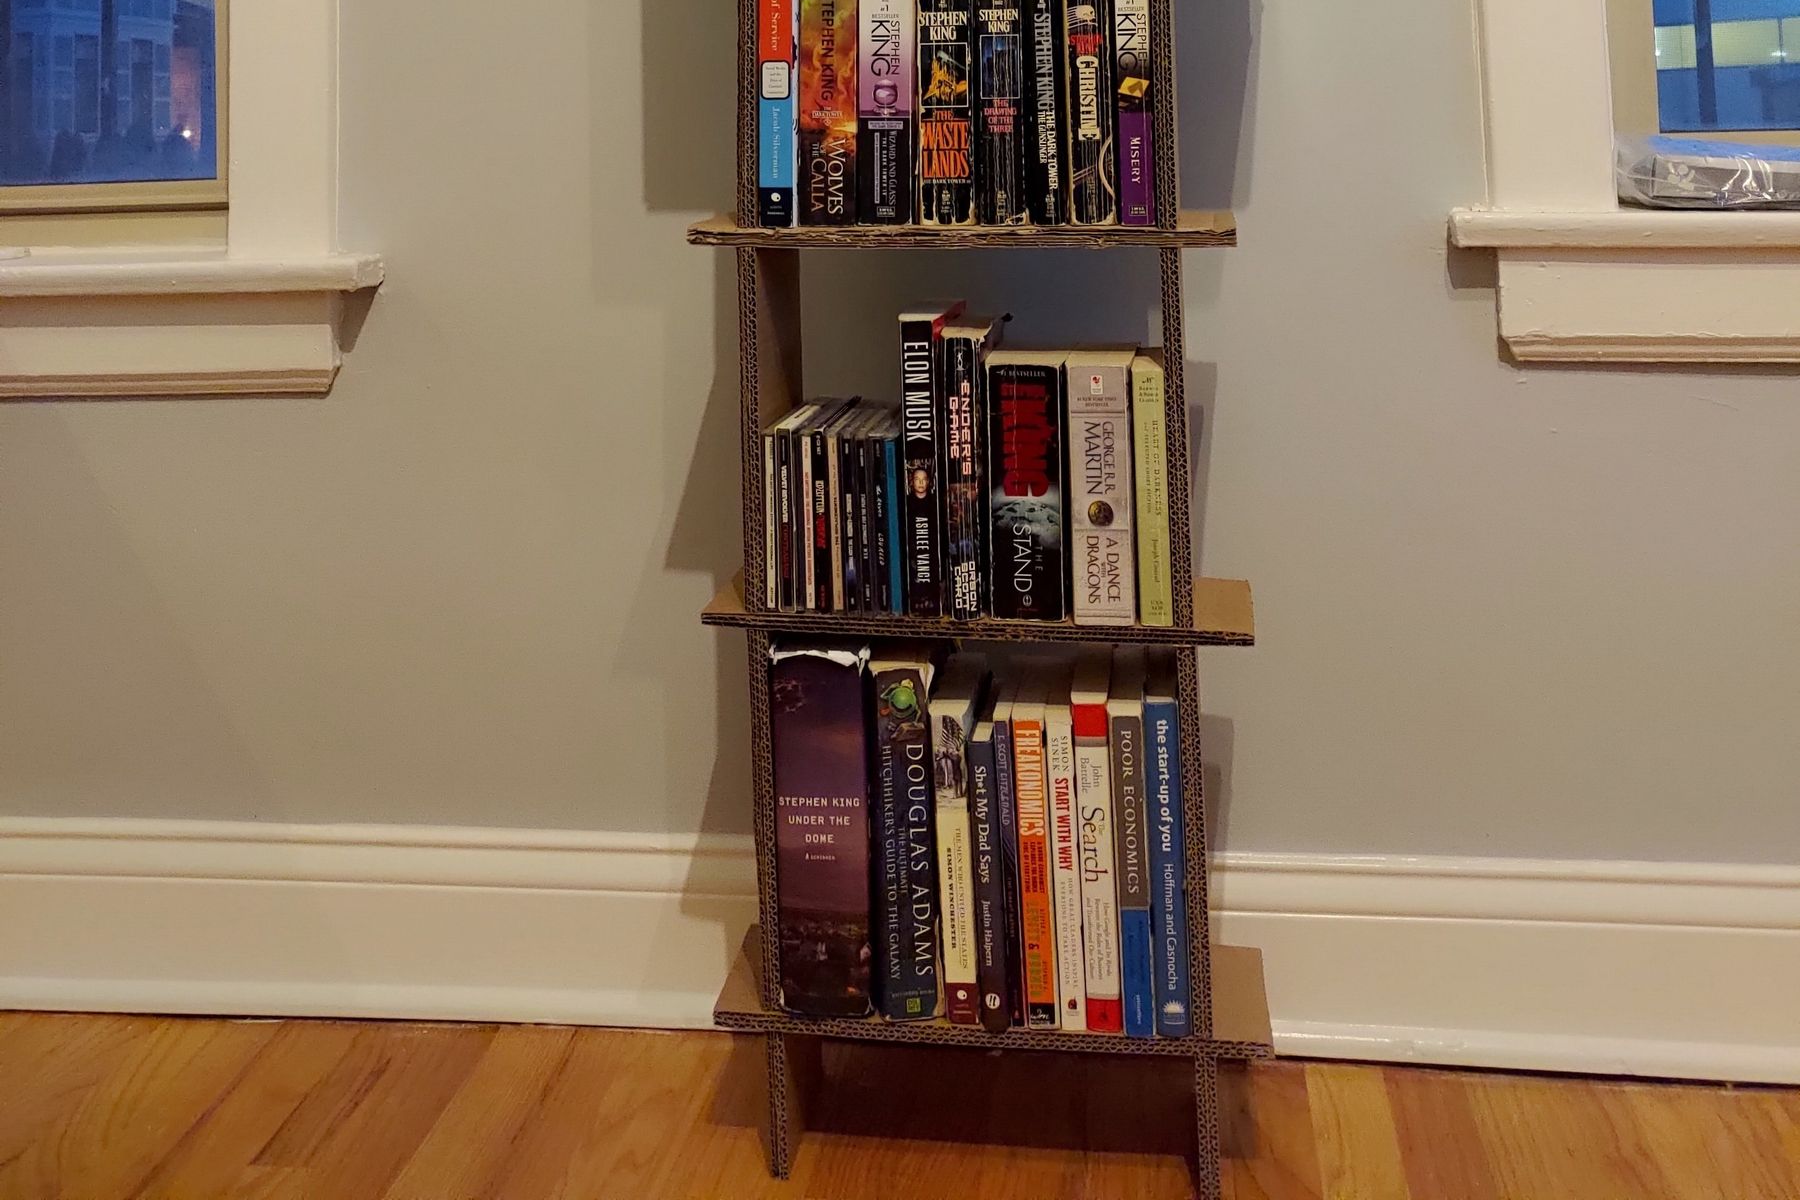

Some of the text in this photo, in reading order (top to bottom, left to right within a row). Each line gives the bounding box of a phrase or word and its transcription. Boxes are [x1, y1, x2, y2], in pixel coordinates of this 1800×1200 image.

[770, 12, 781, 52] Service
[919, 11, 967, 27] STEPHEN
[929, 25, 957, 42] KING
[979, 8, 1019, 22] STEPHEN
[988, 20, 1010, 34] KING
[870, 19, 891, 77] KING
[890, 20, 901, 75] STEPHEN
[1034, 13, 1055, 111] STEPHEN KING
[1117, 13, 1138, 71] KING
[821, 63, 835, 102] KING
[992, 99, 1009, 108] THE
[1076, 55, 1102, 142] CHRISTINE
[922, 120, 969, 151] WASTE
[935, 110, 953, 121] THE
[983, 106, 1017, 116] DRAWING
[987, 124, 1014, 133] THREE
[771, 106, 781, 179] Jacob Silverman
[811, 142, 820, 157] THE
[1037, 110, 1048, 164] THE GUNSLINGER
[1045, 110, 1059, 190] THE DARK TOWER
[1129, 136, 1142, 186] MISERY
[811, 158, 827, 212] CALLA
[827, 138, 846, 215] WOLVES
[888, 130, 899, 206] WIZARD AND GLASS
[923, 150, 970, 179] LANDS
[903, 341, 932, 442] ELON MUSK
[949, 396, 960, 459] GAME
[961, 379, 972, 476] ENDER'S
[1000, 400, 1050, 498] KING
[1102, 421, 1116, 471] GEORGE
[1151, 419, 1160, 449] HEART
[1084, 421, 1104, 495] MARTIN
[1153, 468, 1163, 517] DARKNESS
[914, 516, 931, 583] ASHLEE VANCE
[1012, 522, 1033, 593] STAND
[1034, 545, 1044, 572] THE
[1086, 535, 1101, 604] DRAGONS
[1106, 537, 1121, 603] A DANCE
[953, 566, 963, 610] CARD
[960, 561, 970, 611] SCOTT
[968, 560, 978, 612] ORSON
[1050, 737, 1061, 772] SINEK
[1060, 735, 1071, 773] SIMON
[1080, 757, 1092, 794] Battelle
[1091, 763, 1103, 788] John
[1120, 730, 1134, 779] POOR
[778, 796, 861, 808] STEPHEN KING
[904, 743, 930, 872] DOUGLAS
[996, 743, 1010, 826] SCOTT FITZGERALD
[1016, 729, 1045, 836] FREAKONOMICS
[1157, 719, 1172, 852] the start-up of you
[788, 815, 851, 826] UNDER THE
[974, 797, 989, 820] My
[1054, 777, 1074, 872] START WITH WHY
[805, 834, 835, 844] DOME
[898, 827, 908, 894] THE ULTIMATE
[977, 822, 990, 852] Dad
[1081, 805, 1109, 883] Search
[1122, 785, 1139, 894] ECONOMICS
[881, 745, 901, 980] HITCHHIKER'S GUIDE TO THE GALAXY
[977, 854, 992, 884] Says
[946, 847, 957, 950] SIMON WINCHESTER
[1068, 897, 1076, 921] GREAT
[911, 883, 935, 977] ADAMS
[981, 899, 995, 967] Justin Halpern
[1061, 922, 1067, 933] TO
[1061, 935, 1069, 954] TAKE
[1069, 923, 1077, 958] LEADERS
[1096, 932, 1104, 948] Rules
[1103, 917, 1112, 938] Google
[1163, 863, 1180, 991] Hoffman and Casnocha
[1097, 956, 1105, 981] Business
